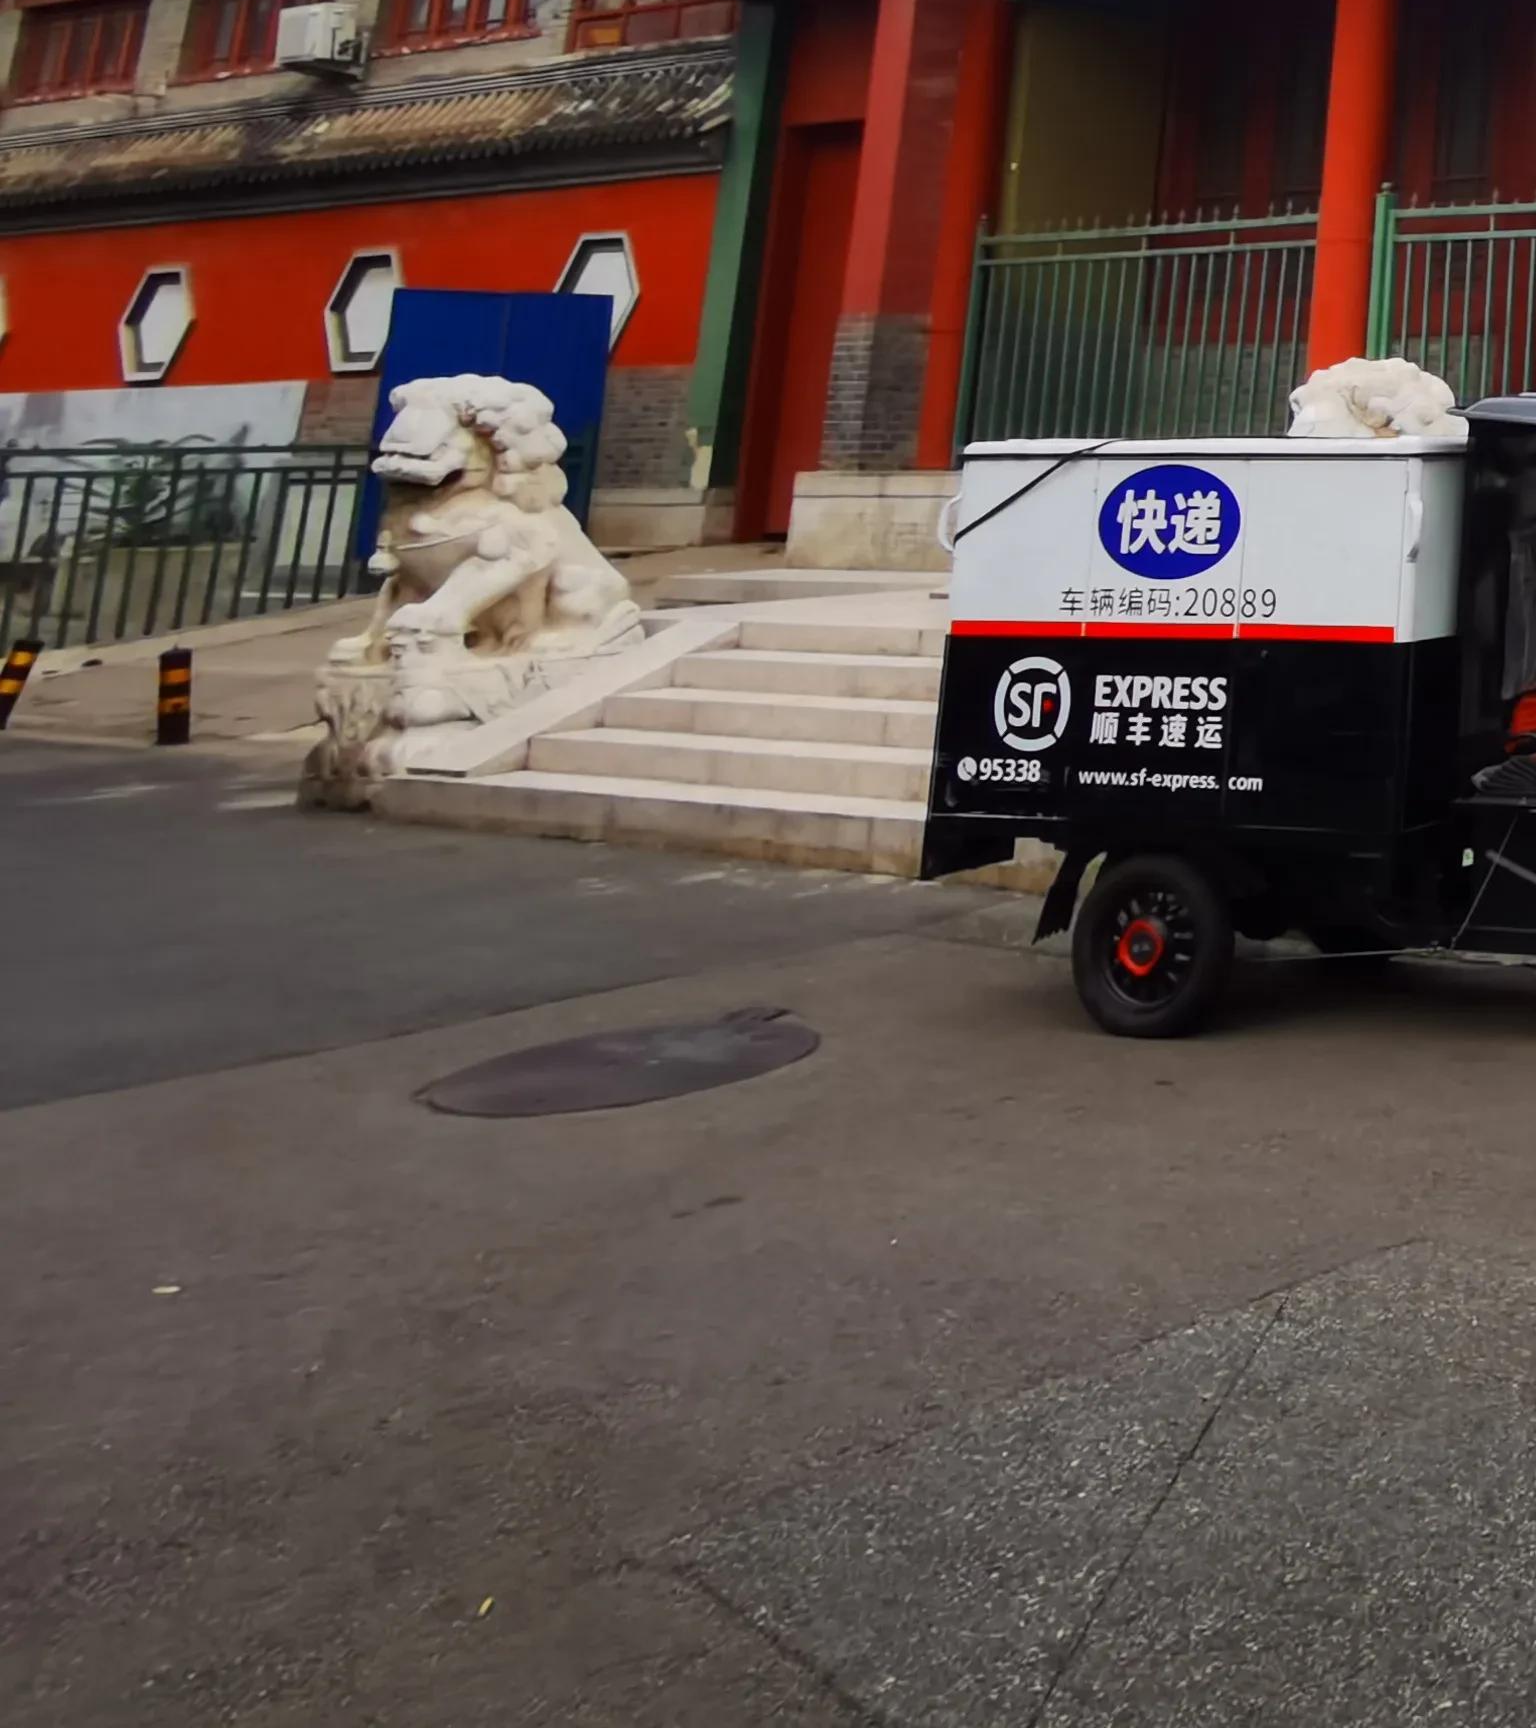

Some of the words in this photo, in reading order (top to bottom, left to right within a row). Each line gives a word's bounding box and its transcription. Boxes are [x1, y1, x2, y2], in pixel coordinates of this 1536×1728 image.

[1116, 489, 1222, 555] 快递
[1093, 674, 1228, 711] EXPRESS
[1089, 711, 1223, 749] 顺丰速运
[978, 757, 1041, 783] 95338
